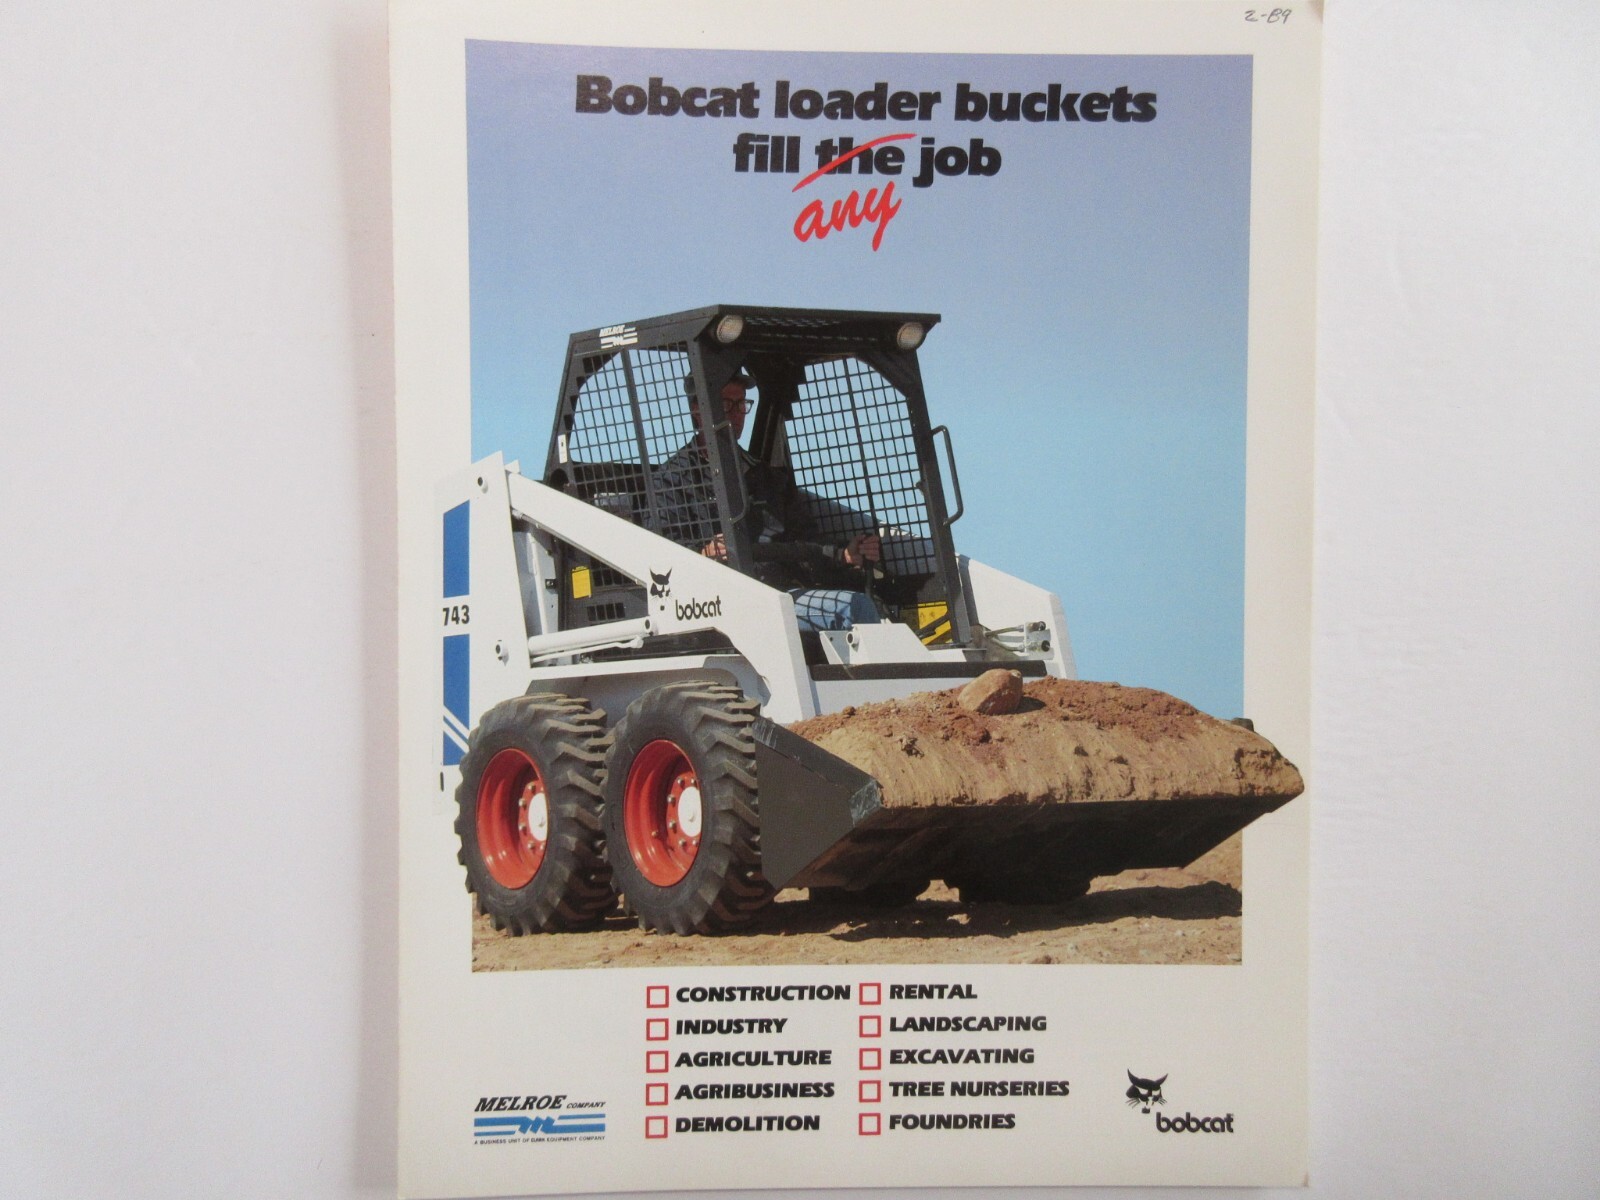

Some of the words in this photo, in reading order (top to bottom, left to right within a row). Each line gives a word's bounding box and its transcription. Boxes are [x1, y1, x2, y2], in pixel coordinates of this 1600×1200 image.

[576, 75, 760, 118] Bobcat
[775, 81, 941, 120] loader
[955, 83, 1156, 122] buckets
[733, 133, 800, 173] fill
[815, 137, 905, 175] the
[913, 137, 1001, 187] job
[794, 182, 902, 251] any
[442, 604, 470, 626] 743
[675, 595, 722, 621] bobcat
[676, 985, 850, 1002] CONSTRUCTION
[890, 985, 977, 999] RENTAL
[677, 1019, 787, 1034] INDUSTRY
[890, 1016, 1046, 1031] LANDSCAPING
[675, 1050, 831, 1067] AGRICULTURE
[890, 1049, 1034, 1064] EXCAVATING
[675, 1083, 834, 1099] AGRIBUSINESS
[889, 1082, 944, 1096] TREE
[951, 1081, 1069, 1096] NURSERIES
[474, 1095, 567, 1112] MELROE
[566, 1101, 606, 1109] COMPANY
[676, 1116, 819, 1132] DEMOLITION
[890, 1114, 1015, 1129] FOUNDRIES
[1155, 1111, 1234, 1133] bobcat
